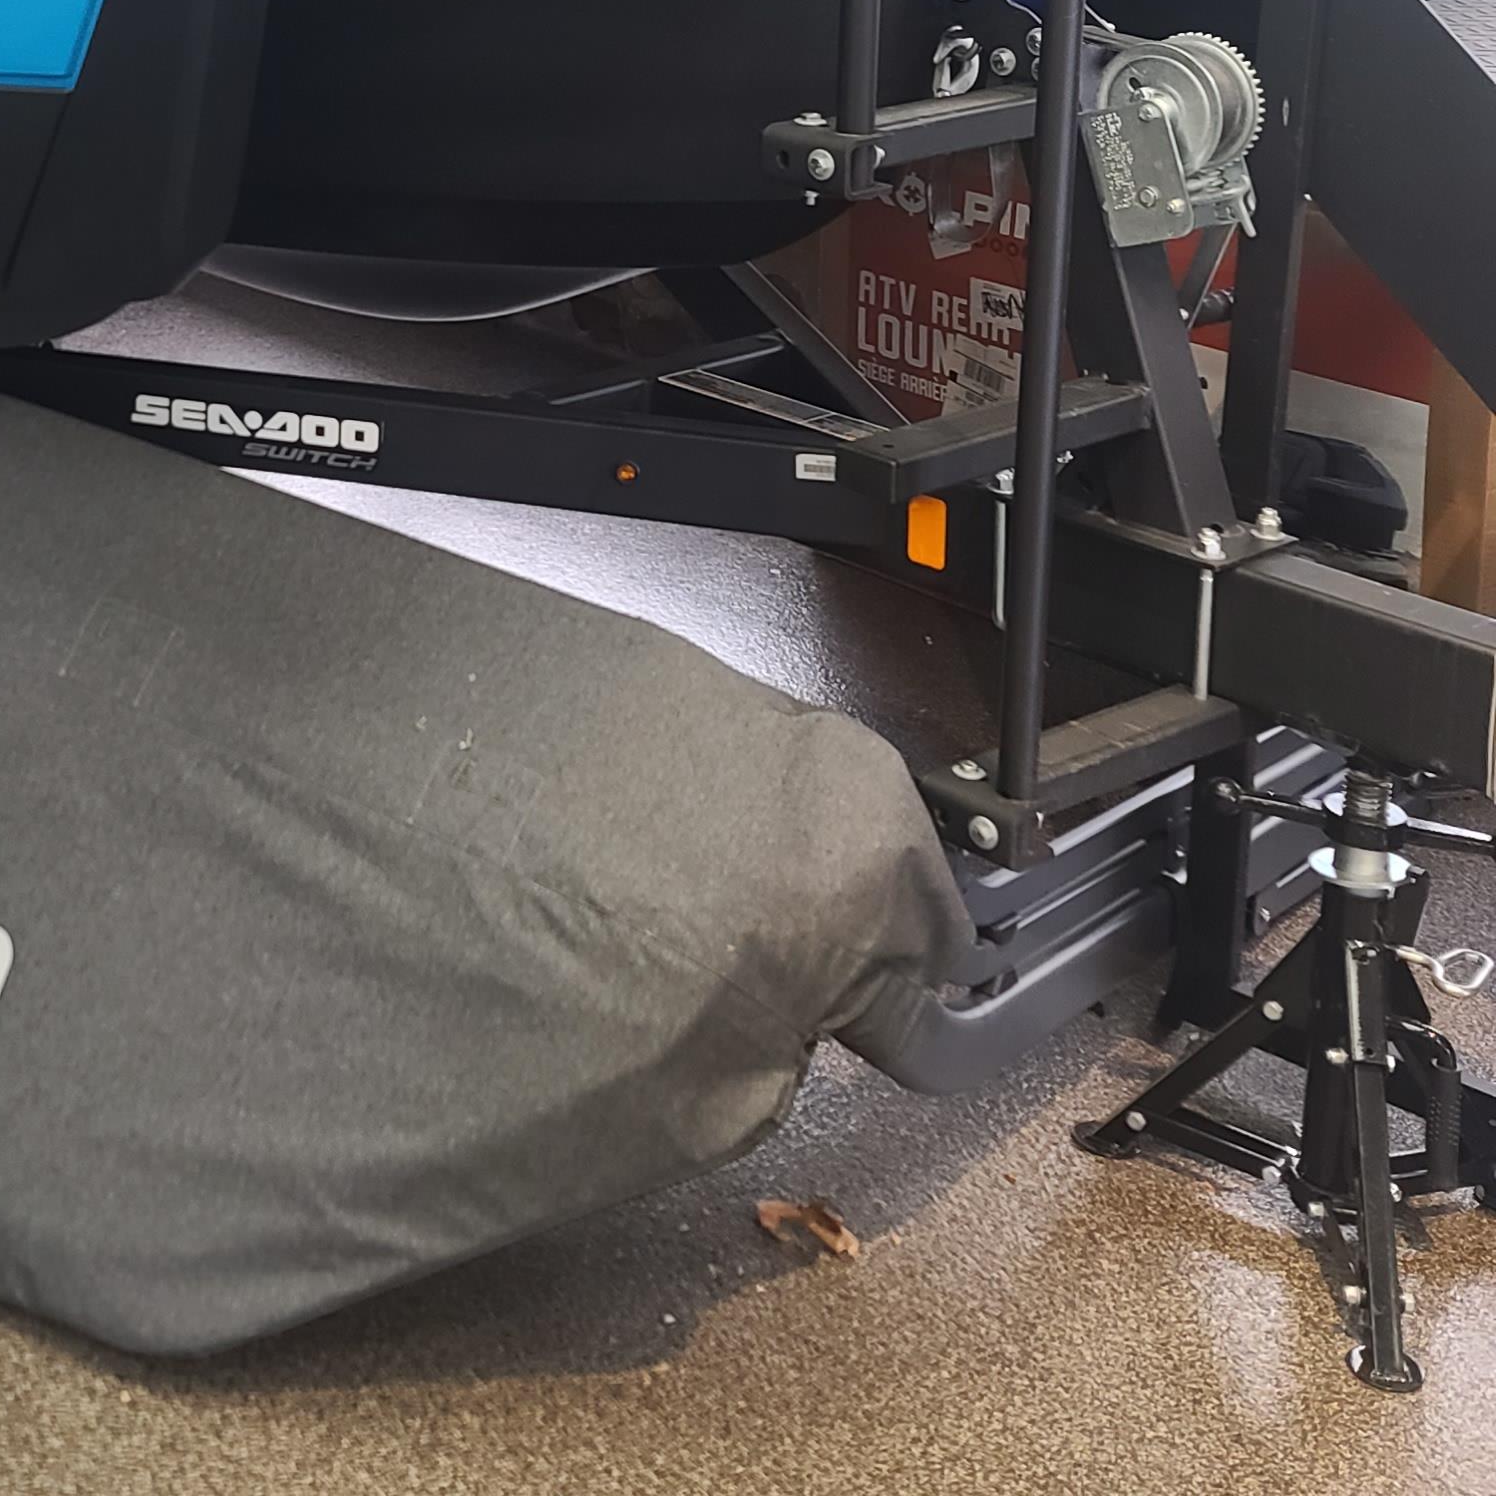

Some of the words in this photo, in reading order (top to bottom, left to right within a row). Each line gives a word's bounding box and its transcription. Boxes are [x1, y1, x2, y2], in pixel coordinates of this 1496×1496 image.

[858, 270, 917, 317] ATV
[857, 306, 960, 378] LOUN
[900, 372, 948, 403] ARRIÈR
[241, 441, 378, 471] SWITCH
